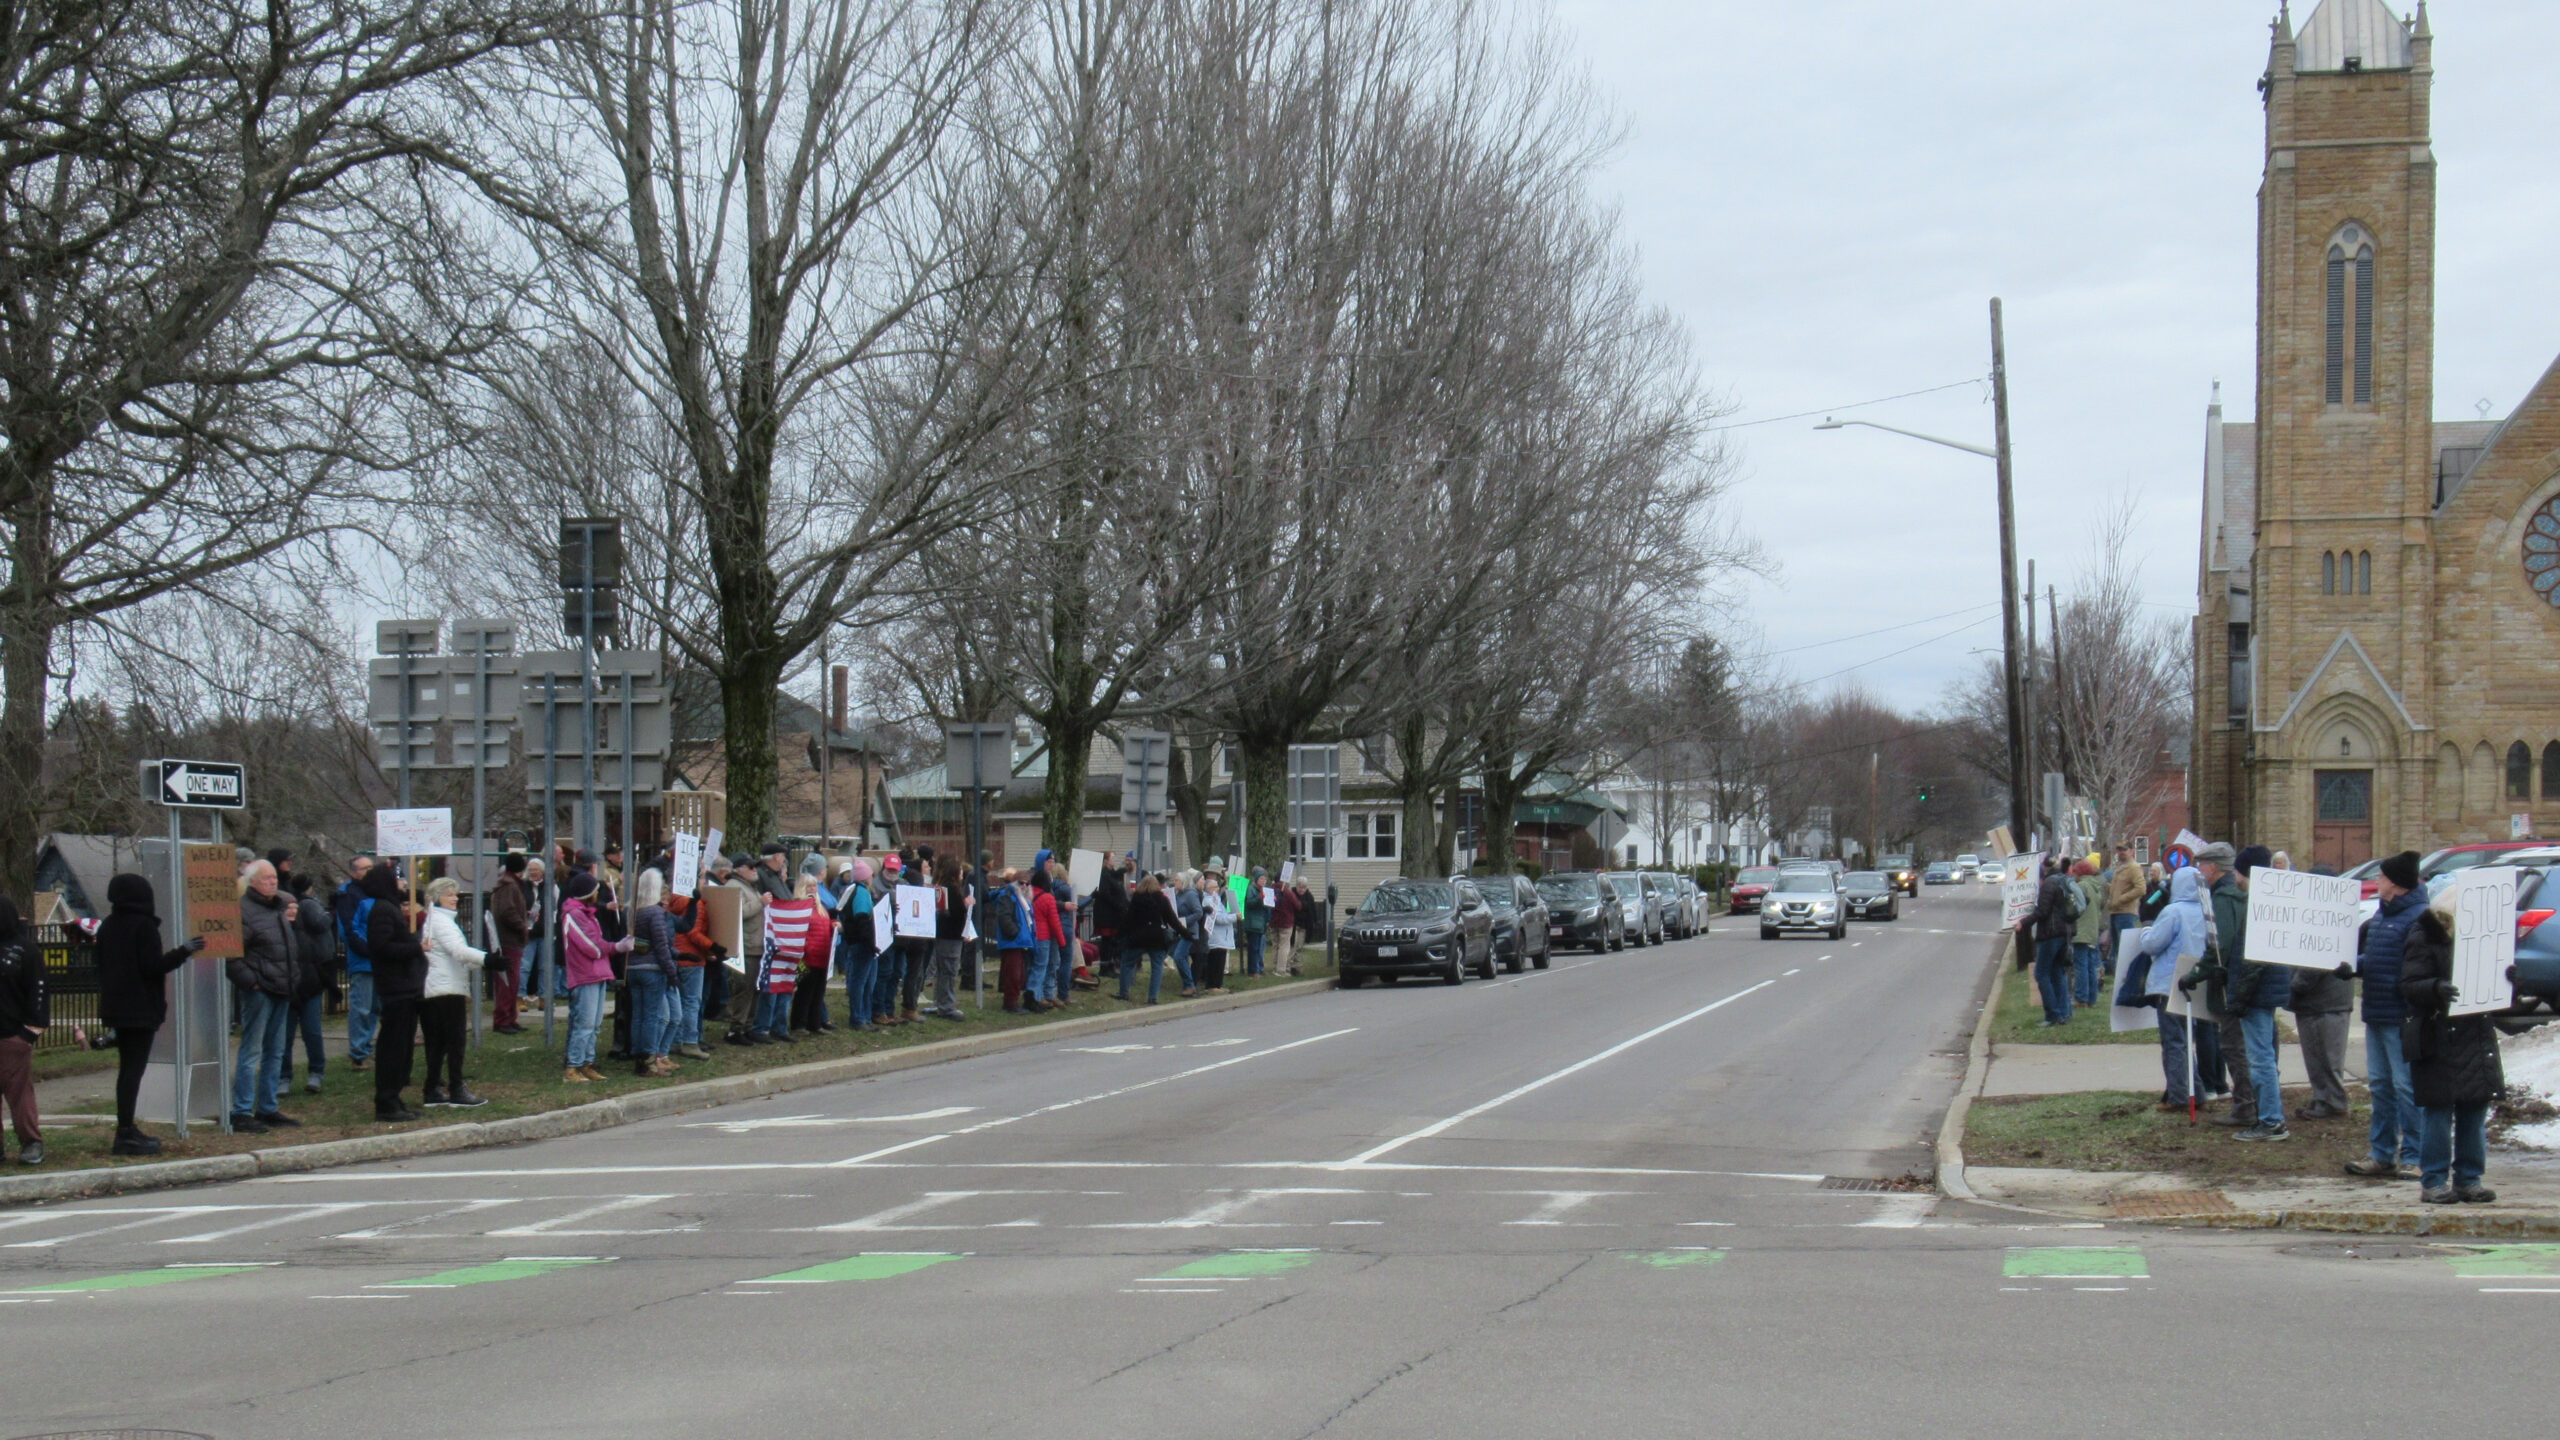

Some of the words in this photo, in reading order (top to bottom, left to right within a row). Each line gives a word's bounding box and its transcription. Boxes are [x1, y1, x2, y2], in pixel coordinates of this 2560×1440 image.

[186, 774, 209, 792] ONE
[212, 776, 235, 793] WAY
[191, 846, 229, 862] WHEN
[680, 838, 697, 857] ICE
[675, 872, 695, 889] GOOD
[2260, 871, 2303, 895] STOP
[2252, 902, 2299, 924] VIOLENT
[2301, 908, 2353, 928] GESTAPO
[2460, 882, 2515, 936] STOP
[2268, 929, 2291, 949] ICE
[2300, 932, 2340, 953] RAIDS!
[2457, 932, 2509, 1007] ICE
